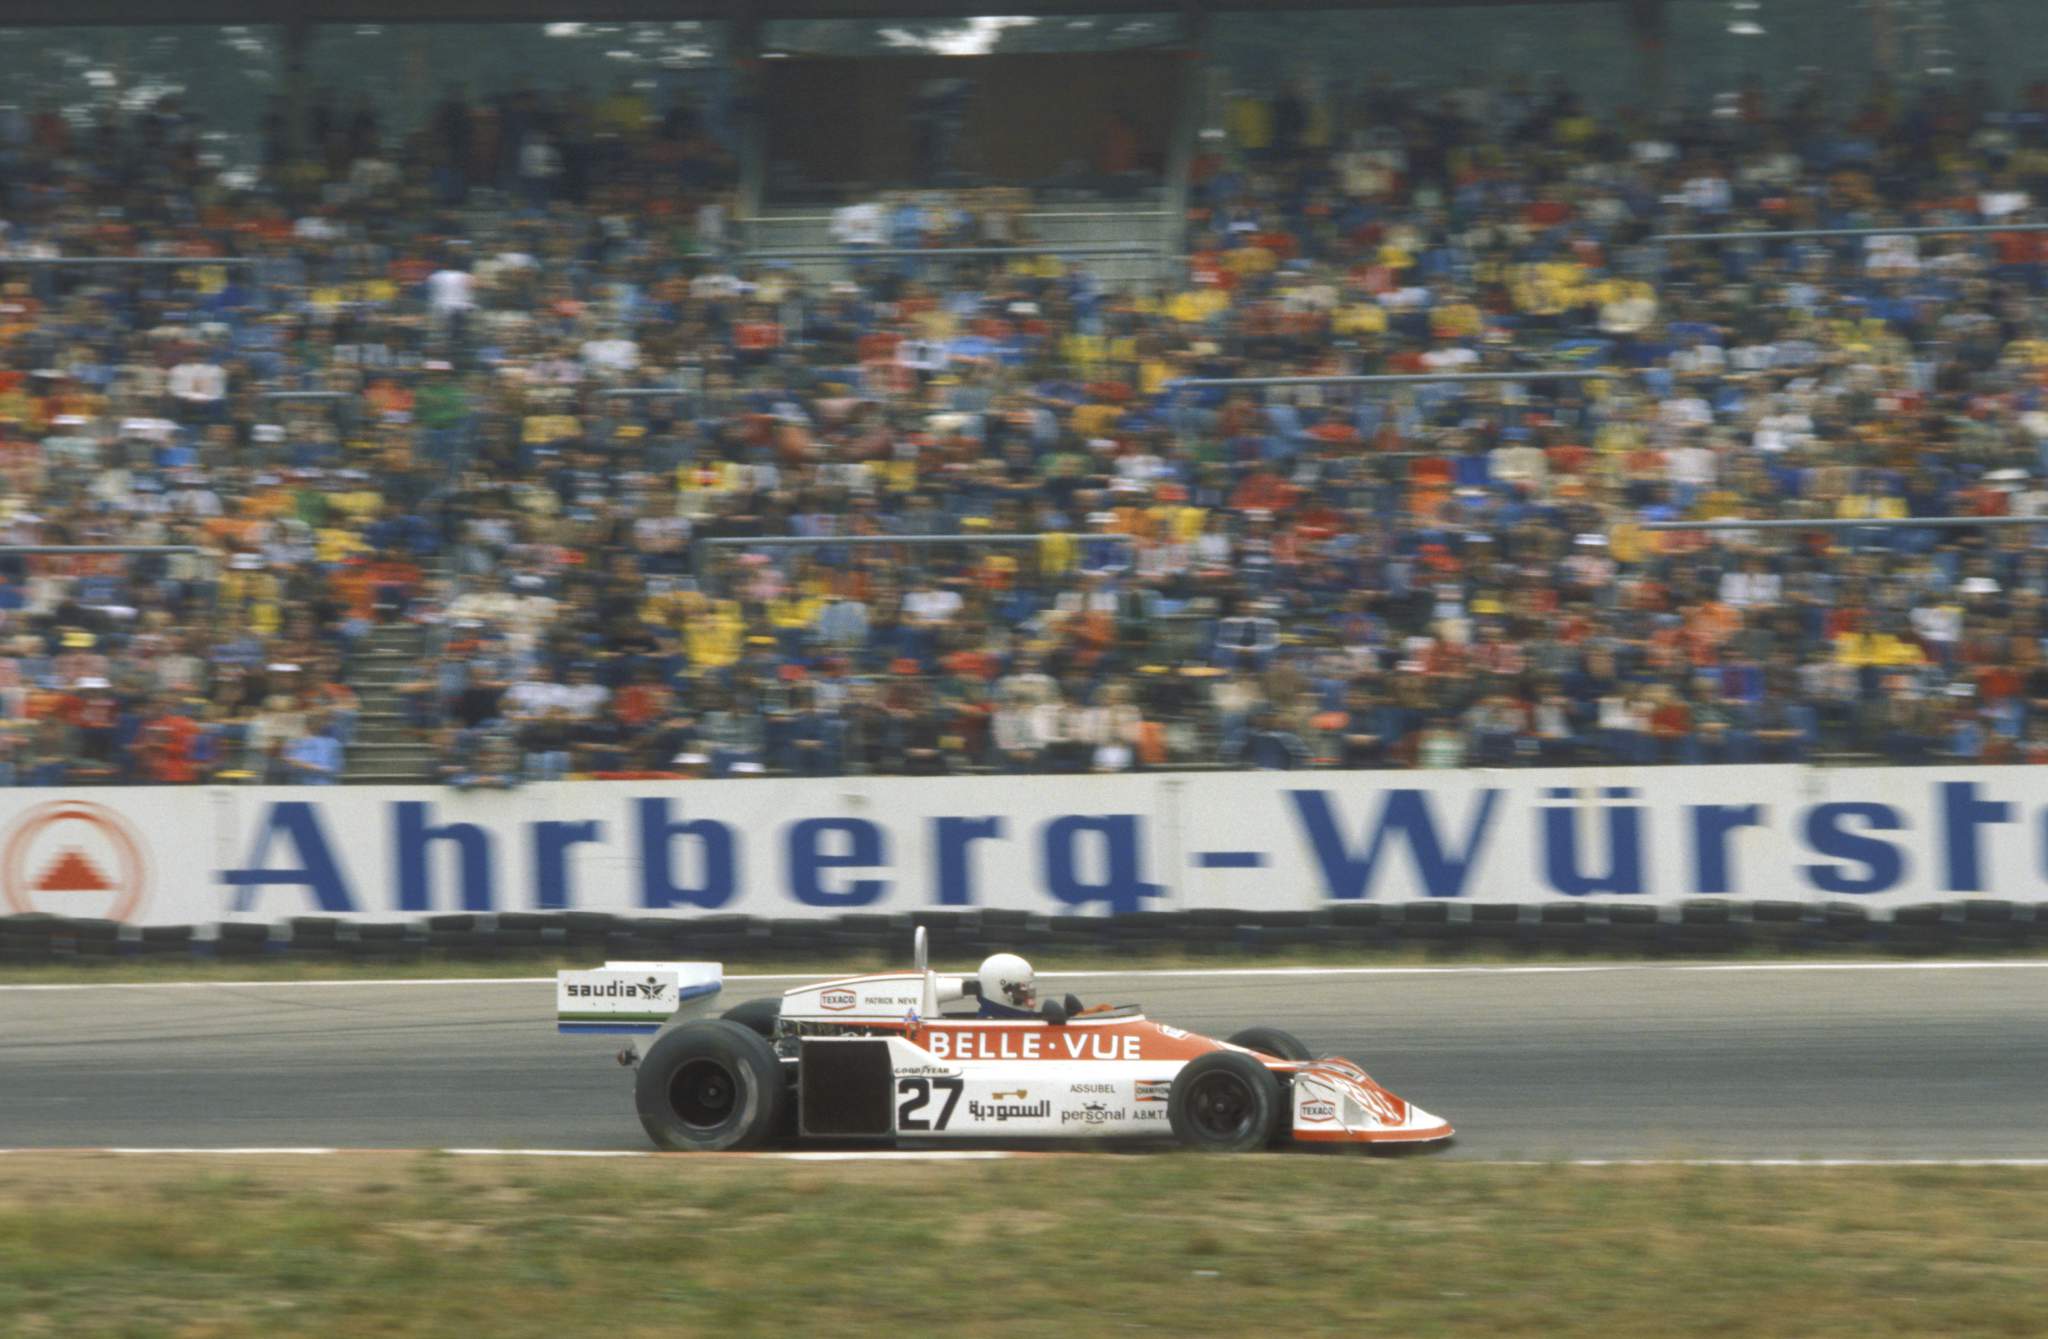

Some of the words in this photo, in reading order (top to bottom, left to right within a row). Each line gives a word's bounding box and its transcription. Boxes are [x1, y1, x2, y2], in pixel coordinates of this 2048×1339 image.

[567, 981, 637, 997] saudia
[822, 995, 855, 1004] TEXACO
[864, 997, 893, 1005] PATRICK
[897, 997, 917, 1005] NEVE
[895, 1065, 949, 1074] GOODYEAR
[1070, 1084, 1116, 1093] ASSUBEL
[898, 1078, 964, 1131] 27
[1061, 1107, 1125, 1124] personal
[1302, 1106, 1334, 1116] TEXACO
